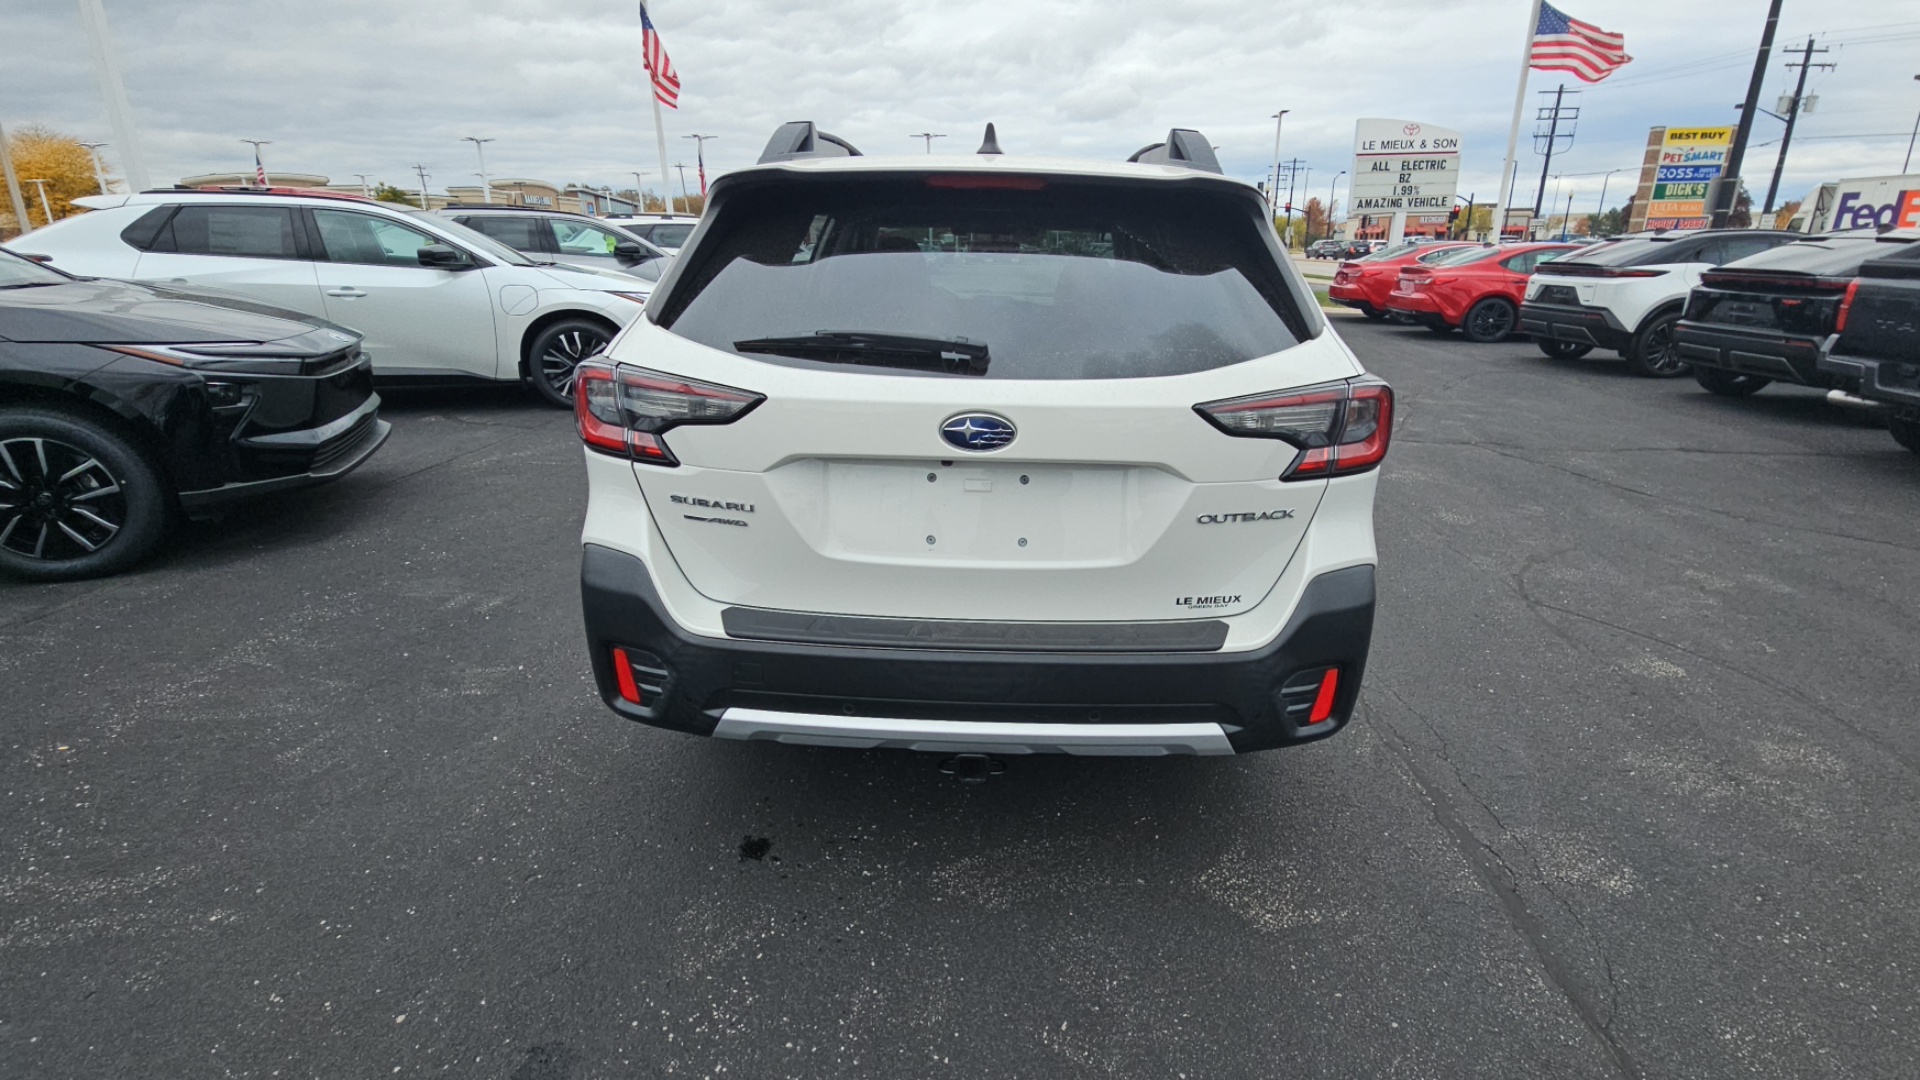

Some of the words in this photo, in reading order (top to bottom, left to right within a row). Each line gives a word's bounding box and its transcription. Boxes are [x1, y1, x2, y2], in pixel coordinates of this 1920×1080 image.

[1670, 132, 1699, 140] BEST
[1700, 132, 1726, 140] BUY
[1362, 140, 1376, 150] LE
[1380, 139, 1415, 150] MIEUX
[1420, 139, 1427, 149] &
[1433, 138, 1458, 149] SON
[1371, 160, 1391, 172] ALL
[1401, 159, 1447, 171] ELECTRIC
[1399, 173, 1411, 183] BZ
[1658, 168, 1694, 178] ROSS
[1393, 185, 1420, 196] 1.99%
[1666, 183, 1705, 195] DICK'S
[1357, 198, 1403, 209] AMAZING
[1407, 197, 1448, 208] VEHICLE
[1653, 202, 1678, 212] ULTA
[1681, 203, 1702, 211] BEAU
[1832, 189, 1920, 231] FedE
[670, 494, 755, 512] SUBARU
[707, 517, 748, 527] AWD
[1197, 509, 1294, 524] OUTBACK
[1176, 597, 1192, 606] LE
[1196, 595, 1241, 605] MIEUX
